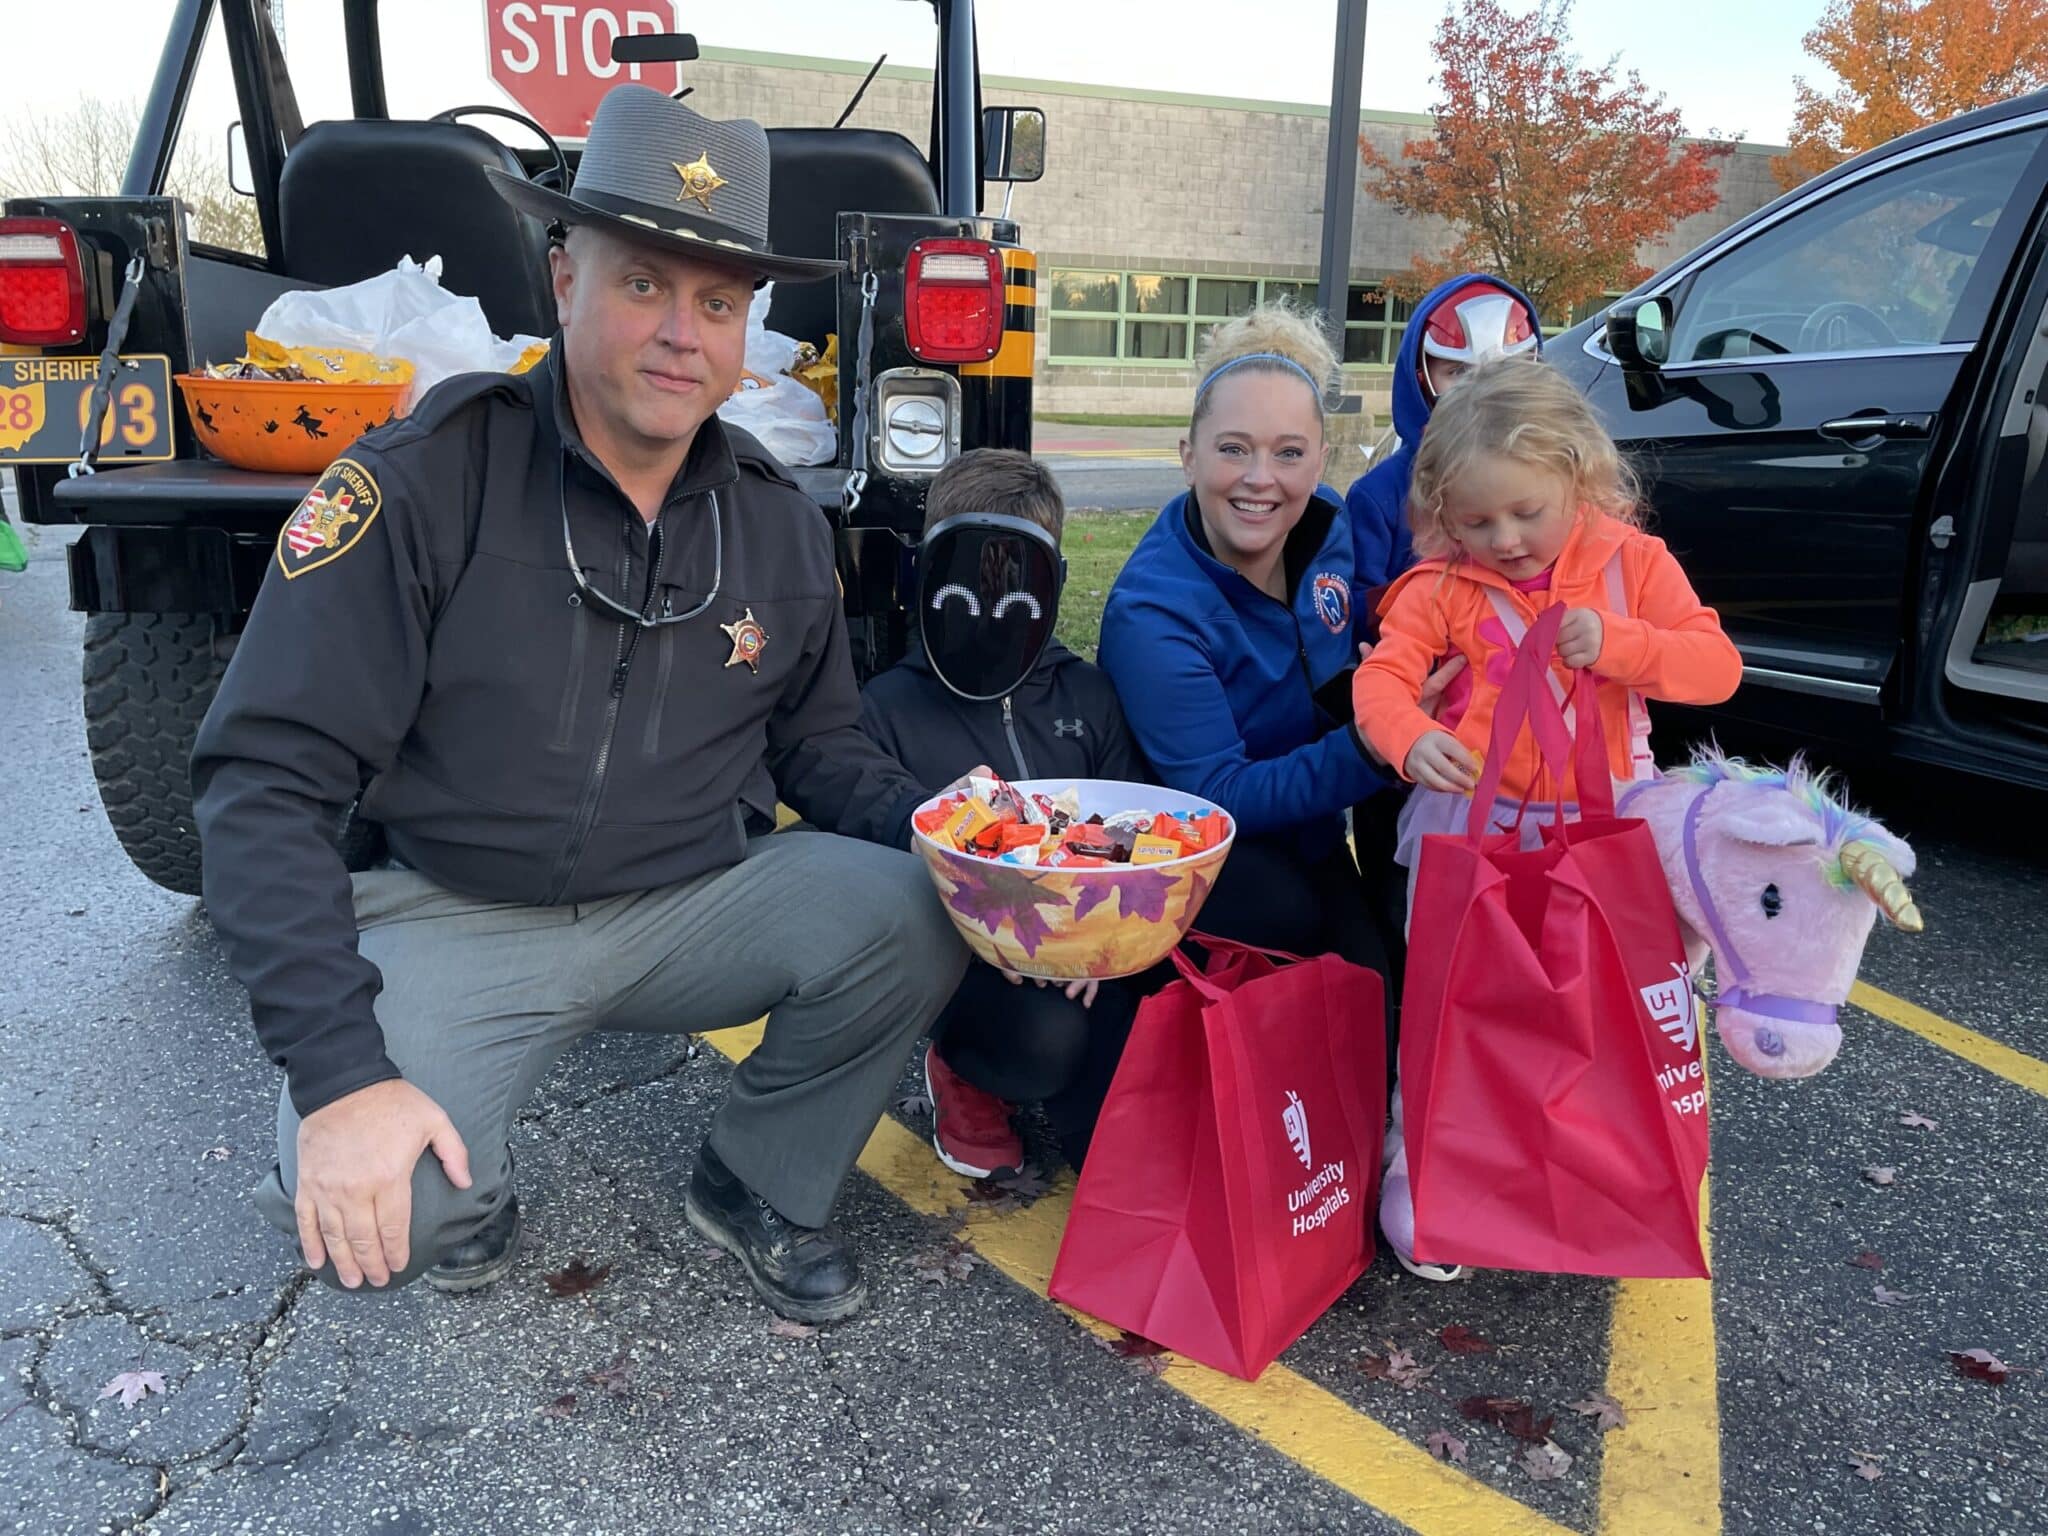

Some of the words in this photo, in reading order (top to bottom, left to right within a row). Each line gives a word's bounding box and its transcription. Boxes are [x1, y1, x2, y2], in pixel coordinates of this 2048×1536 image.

[501, 2, 665, 80] STOP
[0, 393, 33, 430] 8
[340, 466, 374, 506] SHERIFF
[1649, 989, 1677, 1011] UH
[1656, 1057, 1703, 1094] nive
[1287, 1160, 1345, 1212] University
[1292, 1186, 1350, 1237] Hospitals
